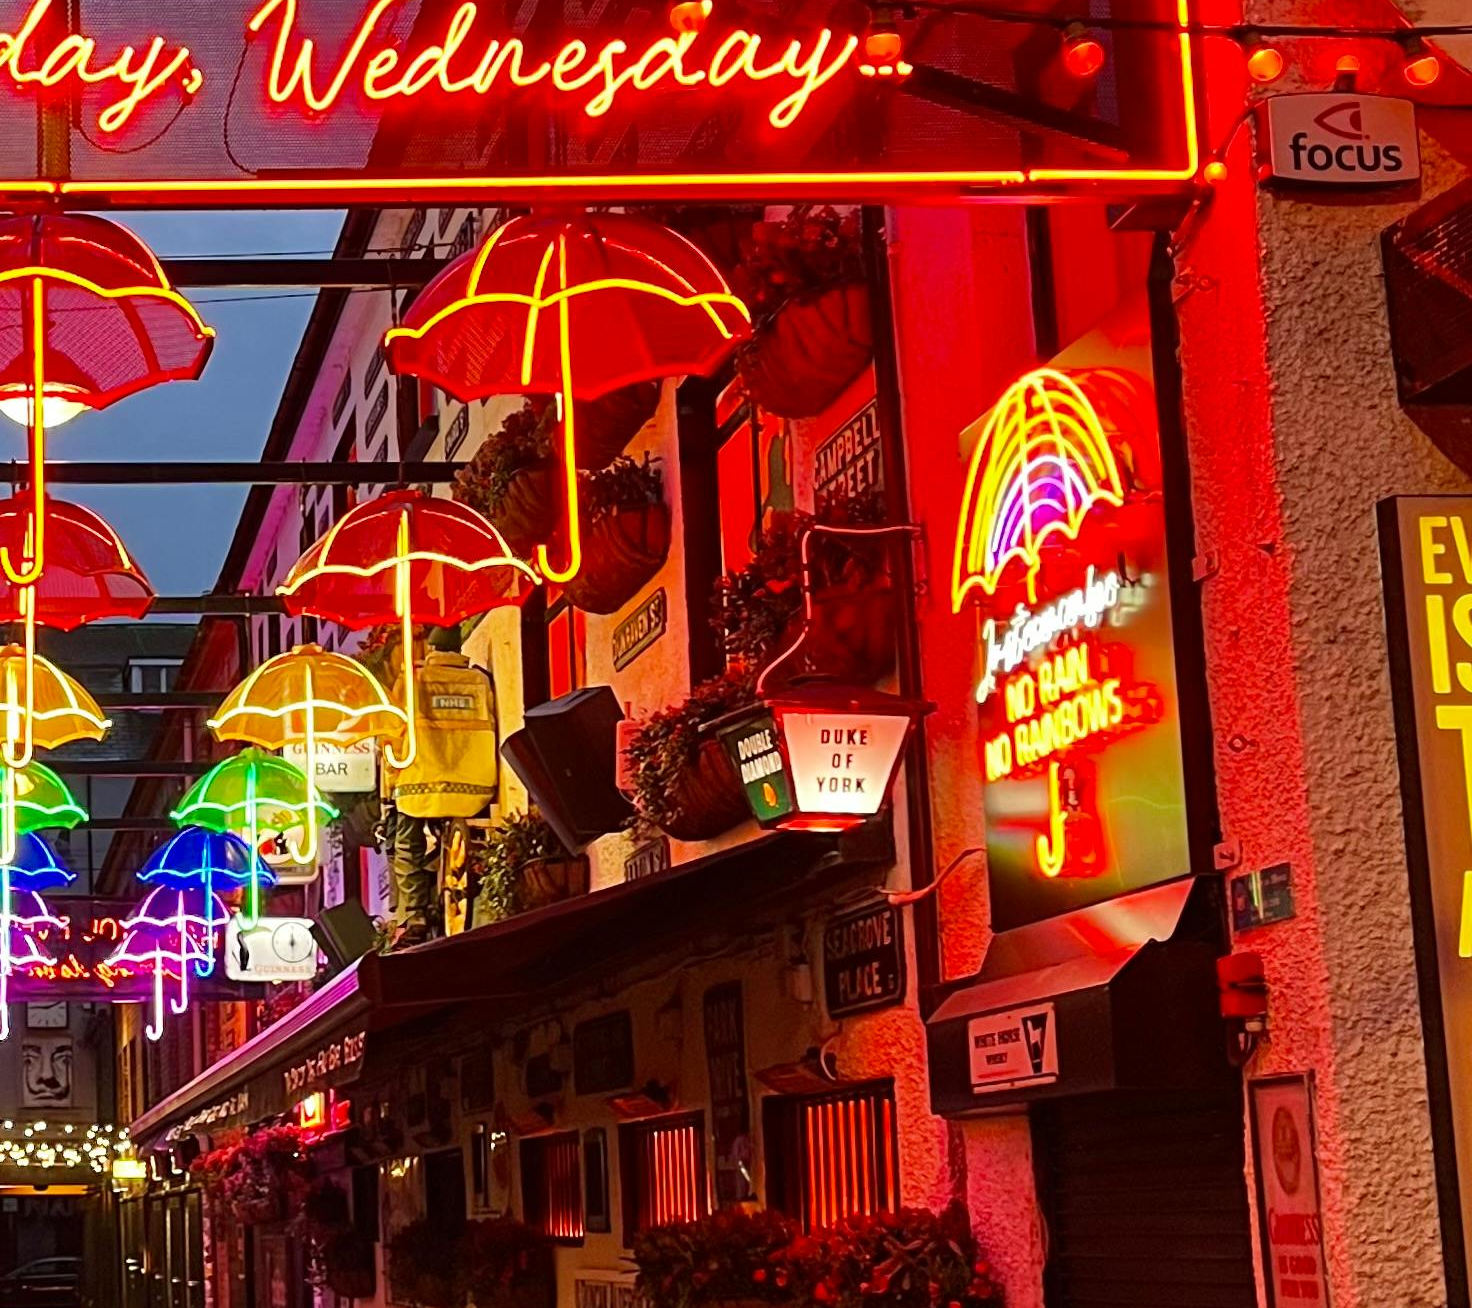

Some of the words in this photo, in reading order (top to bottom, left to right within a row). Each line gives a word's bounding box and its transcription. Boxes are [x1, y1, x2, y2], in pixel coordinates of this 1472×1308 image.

[1289, 132, 1403, 173] focus
[1005, 674, 1036, 723] NO
[1038, 642, 1089, 705] RAIN
[737, 729, 774, 761] DOUBLE
[820, 729, 868, 745] DUKE
[984, 733, 1013, 782] NO
[1014, 678, 1123, 767] RAINBOWS
[315, 762, 348, 776] BAR
[740, 751, 783, 785] DIAMOND
[831, 753, 854, 769] OF
[816, 776, 866, 794] YORK
[839, 961, 882, 1004] PLACE
